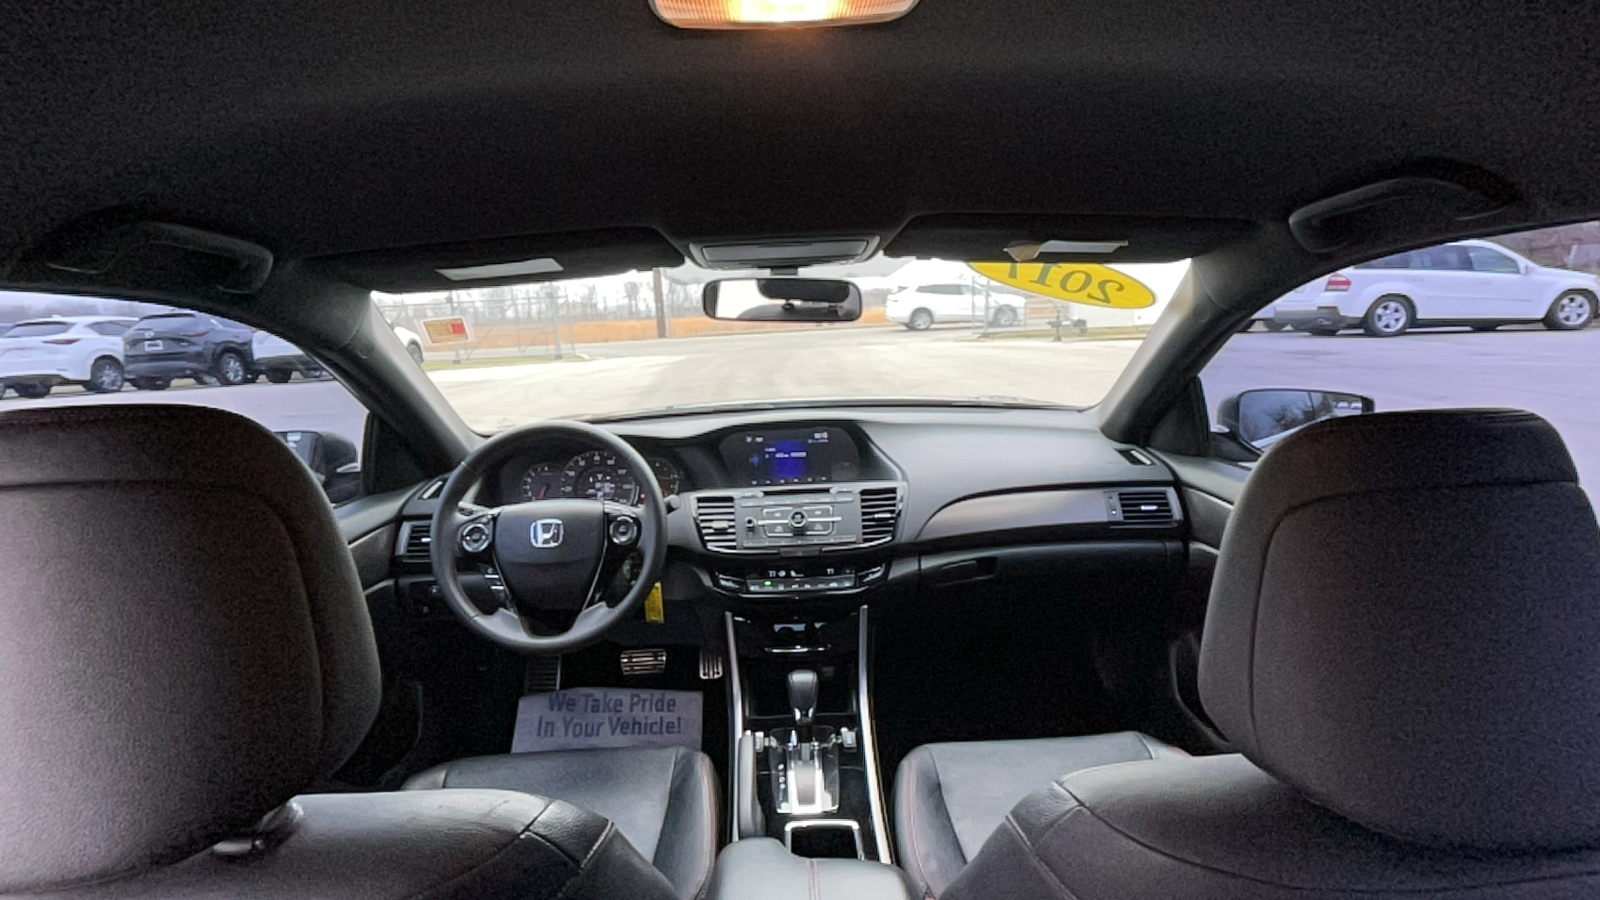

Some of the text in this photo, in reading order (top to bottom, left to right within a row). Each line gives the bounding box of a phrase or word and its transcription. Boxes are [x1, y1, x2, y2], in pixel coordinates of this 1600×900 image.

[549, 691, 677, 714] We Take Pride
[537, 715, 682, 738] In Your Vehicle!
